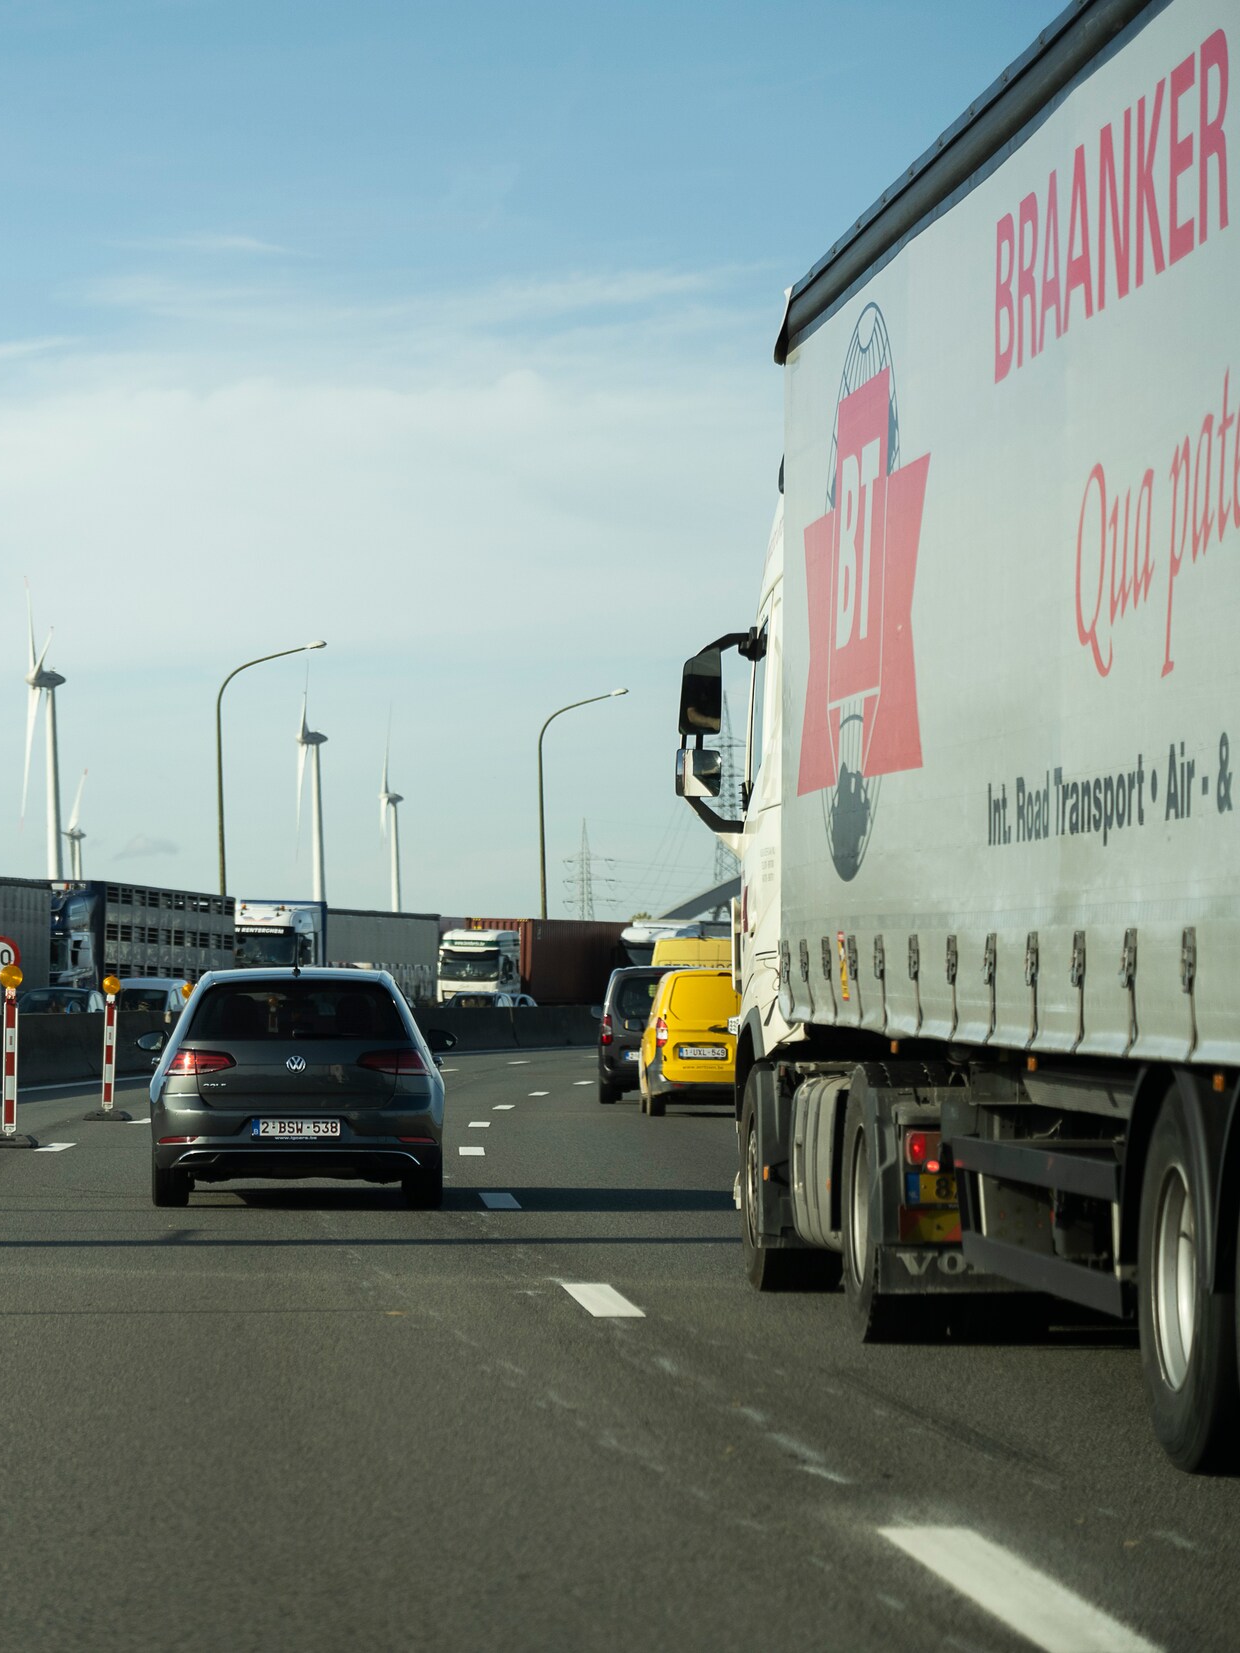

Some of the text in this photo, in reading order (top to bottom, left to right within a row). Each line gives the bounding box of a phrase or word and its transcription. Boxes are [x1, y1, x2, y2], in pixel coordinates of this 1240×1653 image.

[994, 28, 1230, 385] BRAANKER
[835, 436, 881, 651] BT
[1075, 461, 1155, 678] Qua
[987, 782, 1011, 847] Int.
[1016, 769, 1050, 843] Road
[1053, 752, 1145, 847] Transport
[1164, 740, 1196, 822] Air
[261, 1121, 339, 1134] 2-BSW-538
